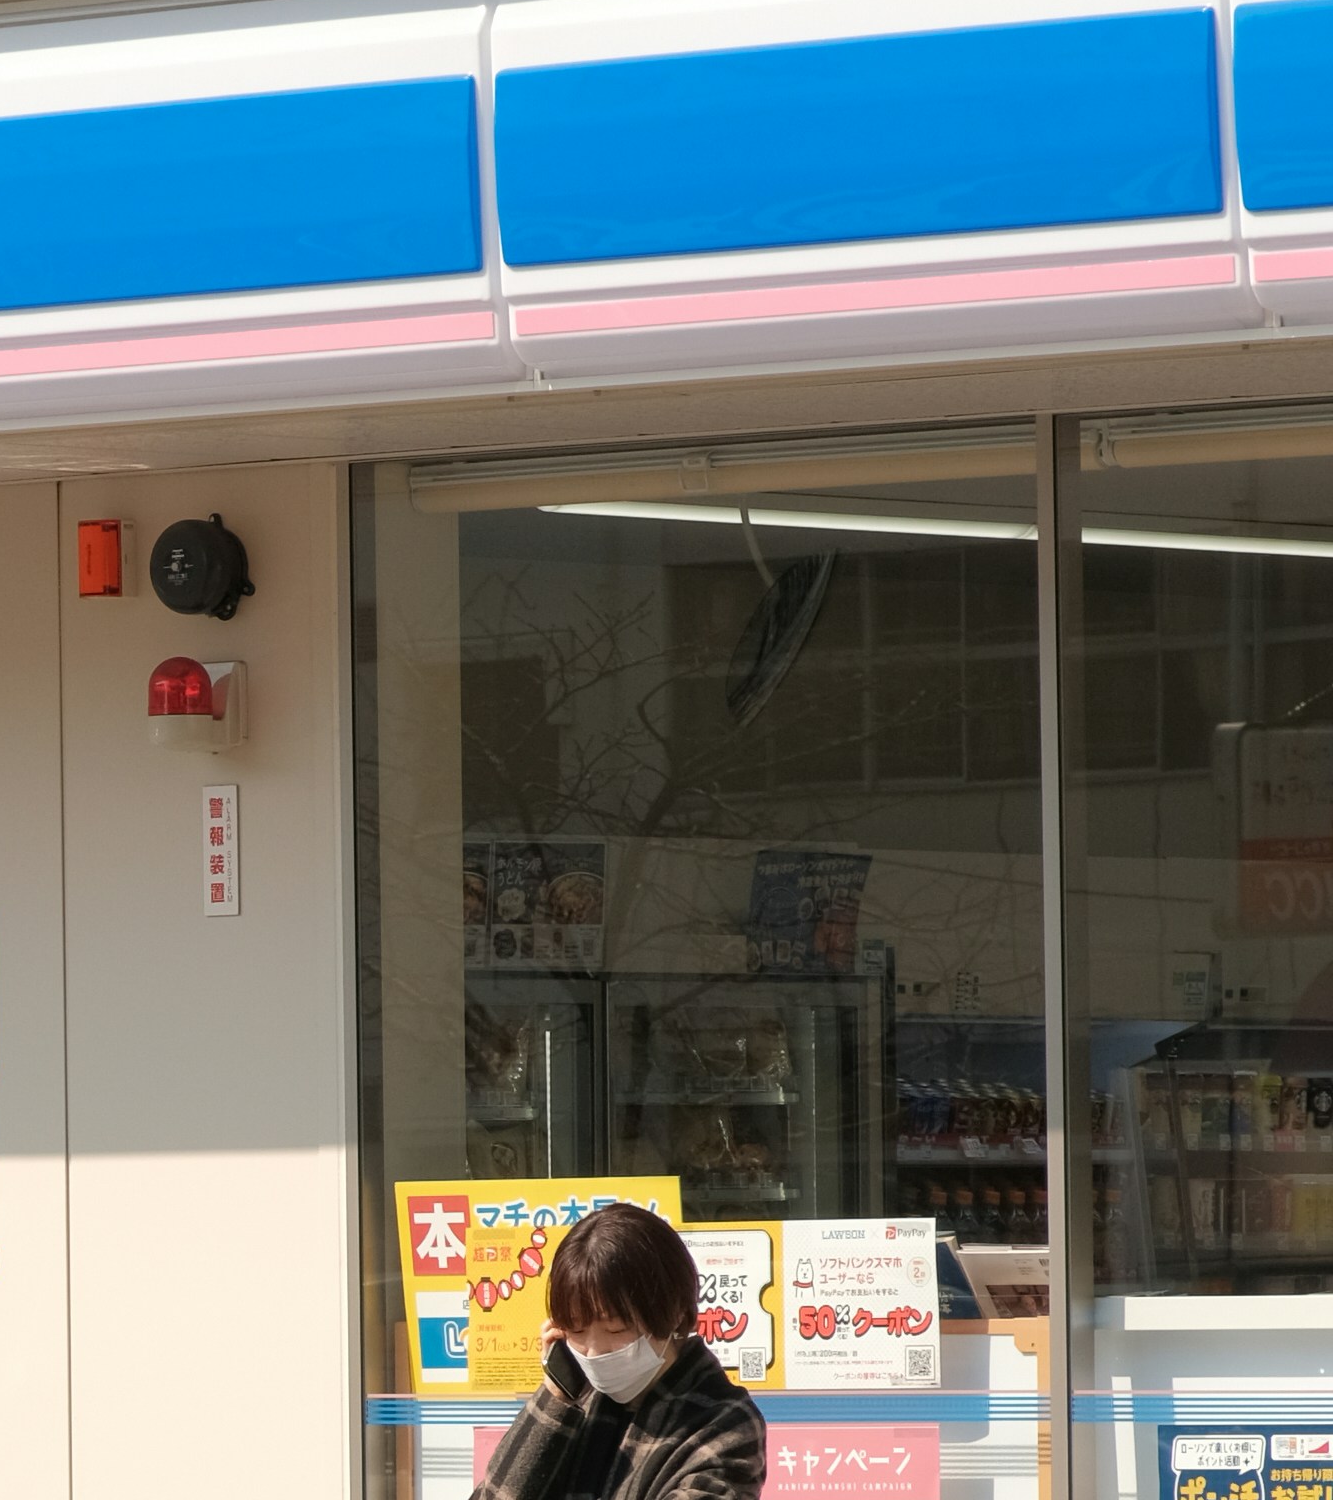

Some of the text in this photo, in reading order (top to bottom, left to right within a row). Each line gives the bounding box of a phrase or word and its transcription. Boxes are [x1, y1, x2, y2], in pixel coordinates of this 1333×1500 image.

[225, 796, 233, 841] ALARM
[208, 796, 226, 904] 警報装置
[414, 1202, 466, 1269] 本
[821, 1228, 926, 1240] LAWSON PayPay
[819, 1256, 903, 1269] ソフトバンクスマホ
[719, 1274, 748, 1287] 戻って
[819, 1272, 876, 1285] ユーザーなら
[721, 1291, 743, 1303] くる!
[852, 1305, 933, 1338] クーポン
[777, 1445, 911, 1476] キャンペーン
